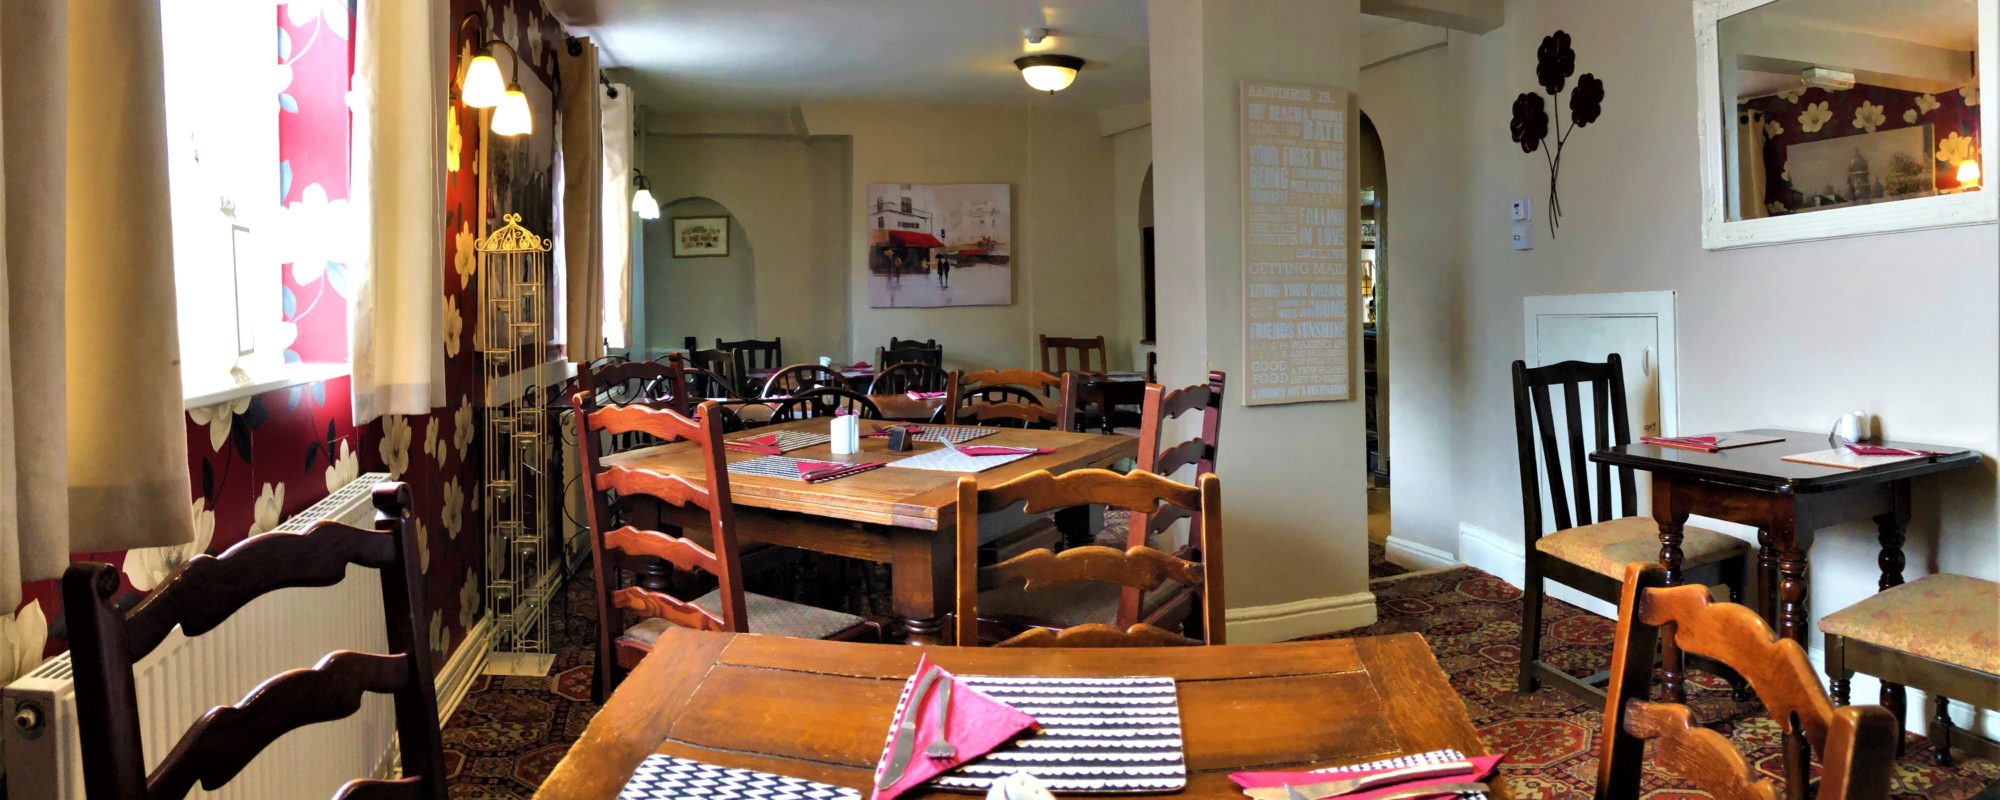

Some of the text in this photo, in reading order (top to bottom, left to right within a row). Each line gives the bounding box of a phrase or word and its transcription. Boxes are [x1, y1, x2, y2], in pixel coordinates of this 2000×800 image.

[1248, 85, 1311, 101] HAPPINESS
[1303, 120, 1344, 142] BATH
[1249, 145, 1279, 166] YOUR
[1320, 149, 1344, 169] KISS
[1249, 166, 1289, 189] BEING
[1299, 207, 1344, 225] FALLING
[1300, 226, 1344, 245] IN LOVE
[1249, 262, 1346, 275] GETTING MAIL
[1283, 283, 1308, 297] YOUR
[1311, 283, 1345, 296] DREAMS
[1315, 300, 1346, 318] HOME
[1249, 321, 1345, 339] FRIENDS SUNSHINE
[1251, 360, 1288, 372] GOOD
[1252, 373, 1289, 384] FOOD
